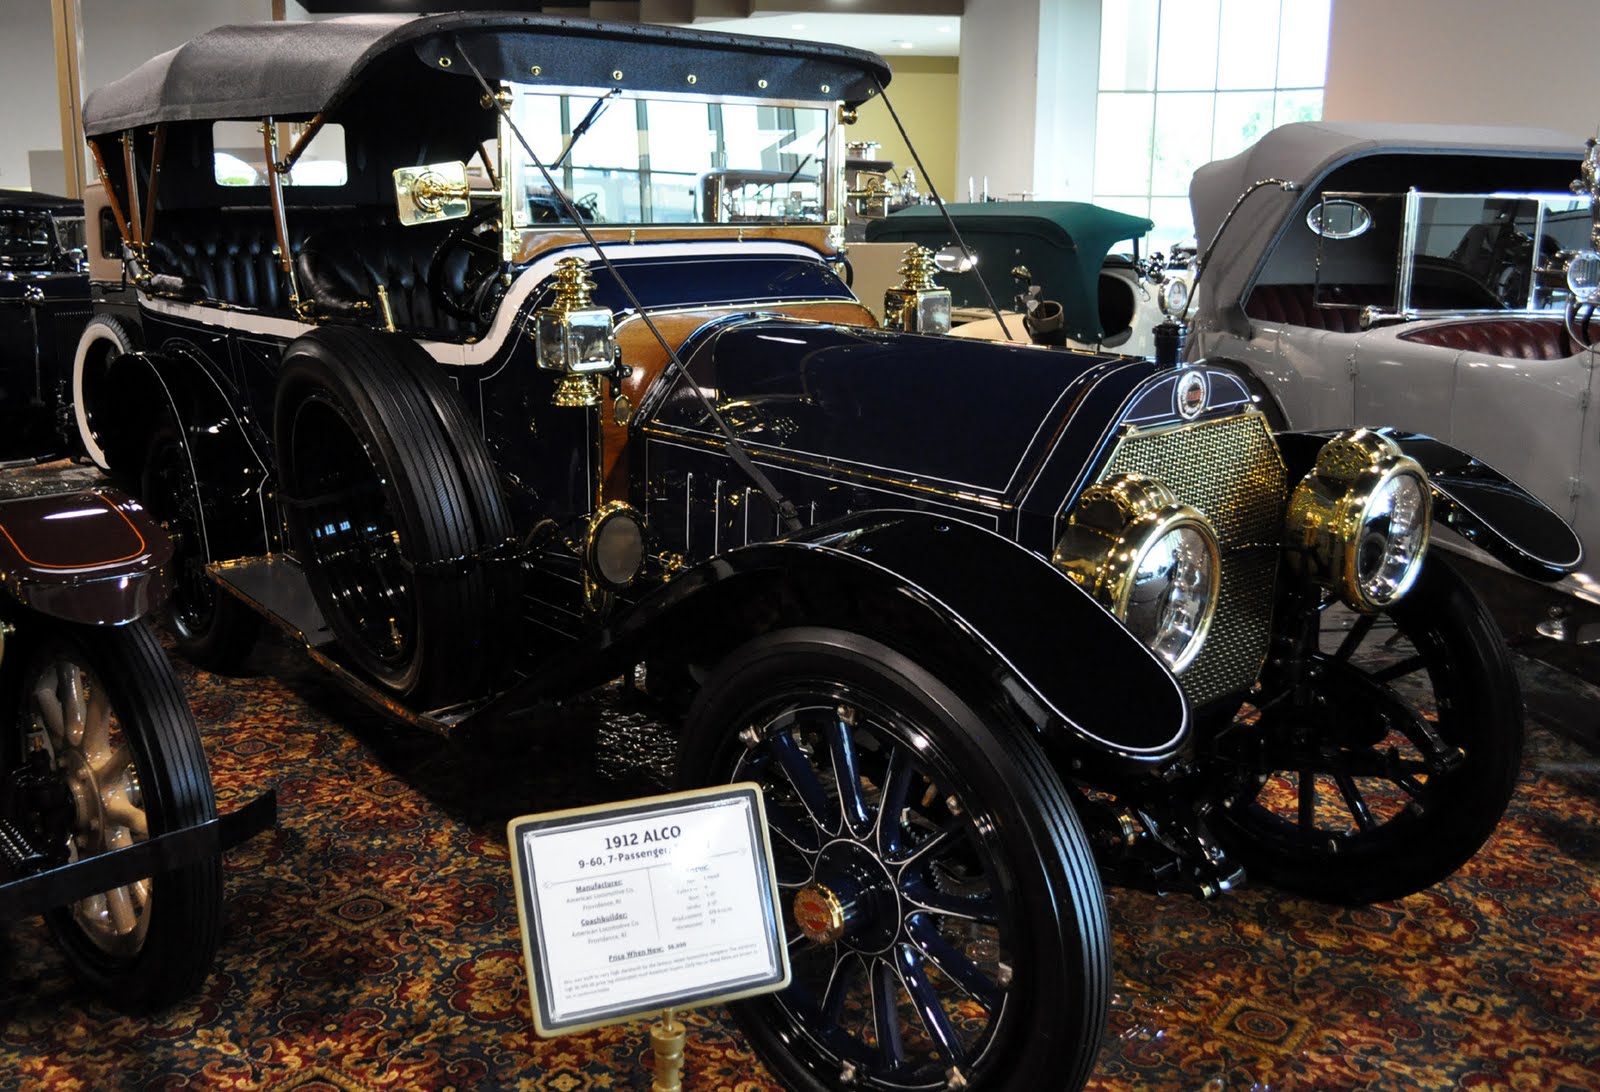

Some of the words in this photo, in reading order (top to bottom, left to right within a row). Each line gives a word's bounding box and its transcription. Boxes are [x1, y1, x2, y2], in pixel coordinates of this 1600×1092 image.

[604, 832, 639, 850] 1912
[643, 825, 682, 843] ALCO
[578, 857, 606, 869] 9-60,
[626, 948, 646, 960] When
